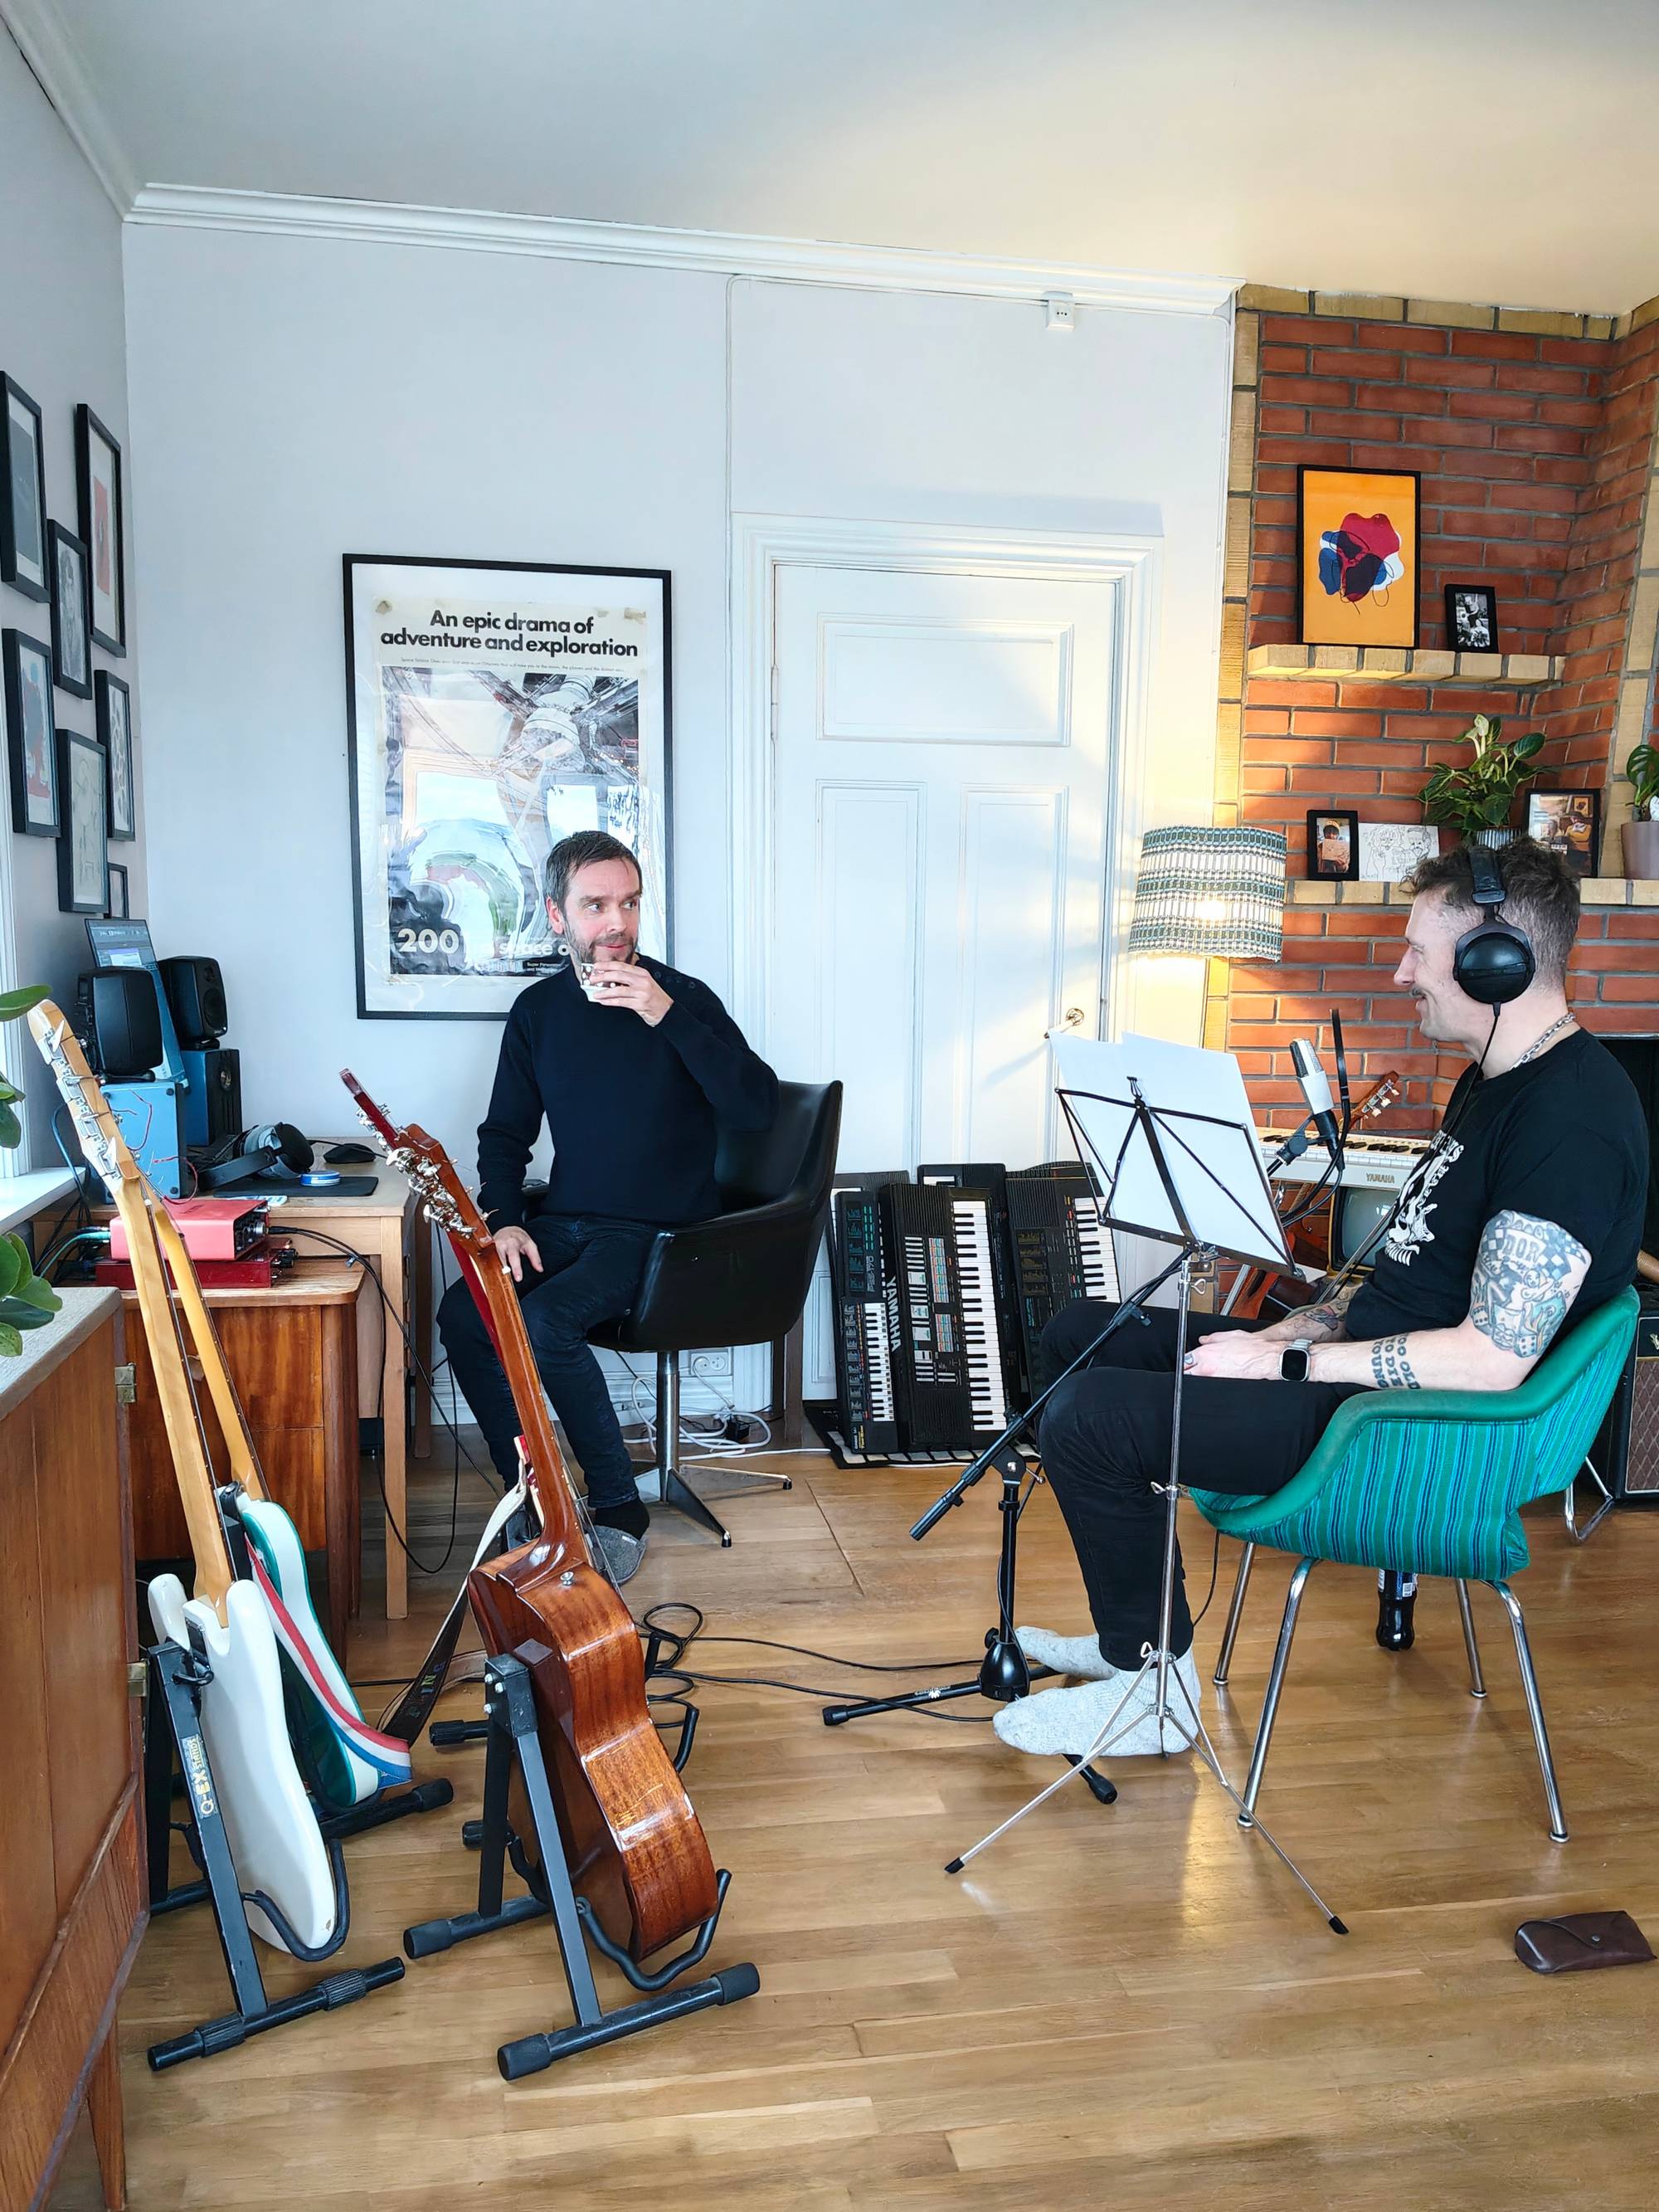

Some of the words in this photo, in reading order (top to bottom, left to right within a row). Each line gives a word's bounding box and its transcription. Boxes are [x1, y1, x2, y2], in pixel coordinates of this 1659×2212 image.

[430, 610, 458, 627] An
[462, 612, 501, 632] epic
[504, 612, 570, 632] drama
[573, 616, 594, 634] of
[381, 628, 482, 649] adventure
[484, 636, 523, 651] and
[525, 636, 638, 658] exploration
[397, 928, 460, 954] 200
[1366, 1172, 1395, 1184] YAMAHA
[885, 1274, 902, 1352] YAMAHA
[1370, 1339, 1388, 1388] YOUNG
[1385, 1355, 1403, 1387] DIE
[192, 1769, 214, 1815] Q-EX
